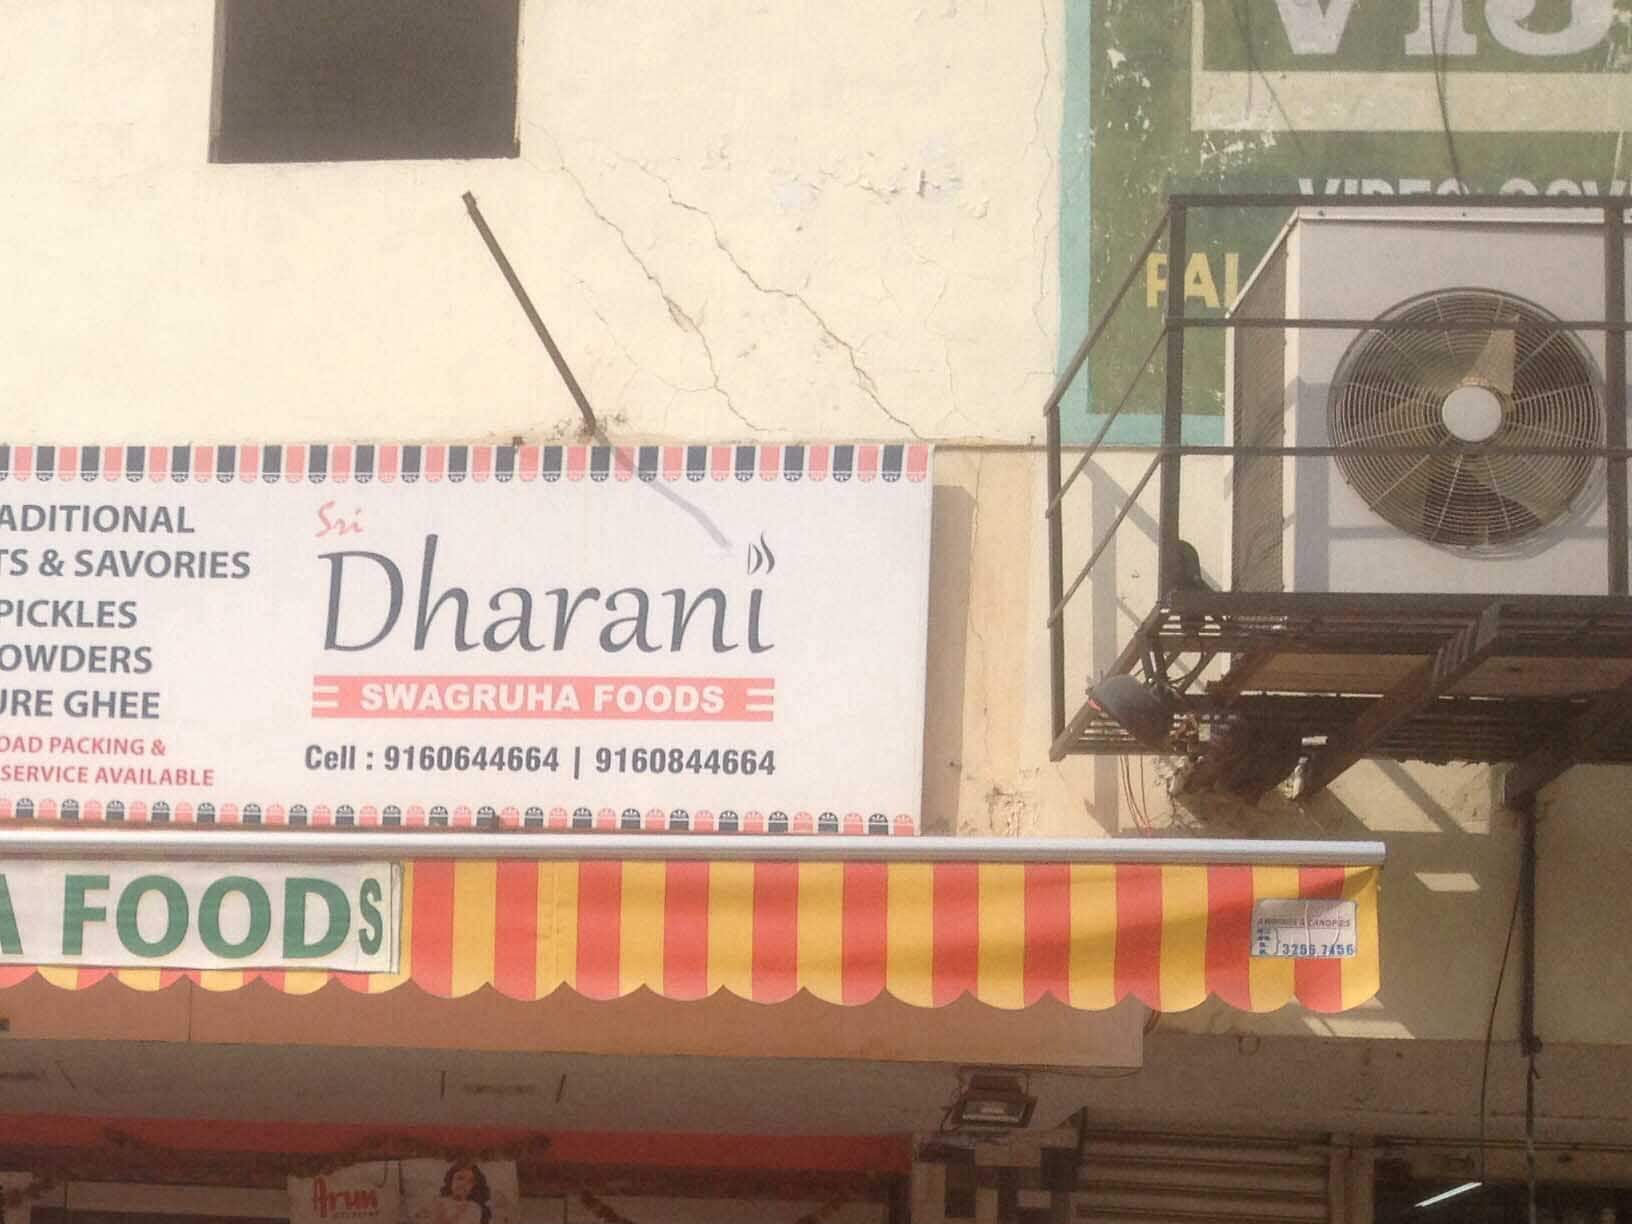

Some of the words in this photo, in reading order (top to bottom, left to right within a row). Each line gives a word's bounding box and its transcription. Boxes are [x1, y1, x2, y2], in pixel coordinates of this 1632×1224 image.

[315, 500, 364, 538] Sri
[39, 549, 65, 577] &
[74, 549, 250, 579] SAVORIES
[317, 532, 776, 654] Dharani
[63, 690, 160, 720] GHEE
[360, 683, 580, 713] SWAGRUHA
[594, 685, 725, 713] FOODS
[49, 736, 145, 756] PACKING
[150, 739, 166, 756] &
[305, 745, 356, 770] Cell
[384, 746, 559, 771] 9160644664
[595, 747, 776, 775] 9160844664
[0, 765, 88, 784] SERVICE
[94, 767, 215, 787] AVAILABLE
[61, 873, 383, 960] FOODS
